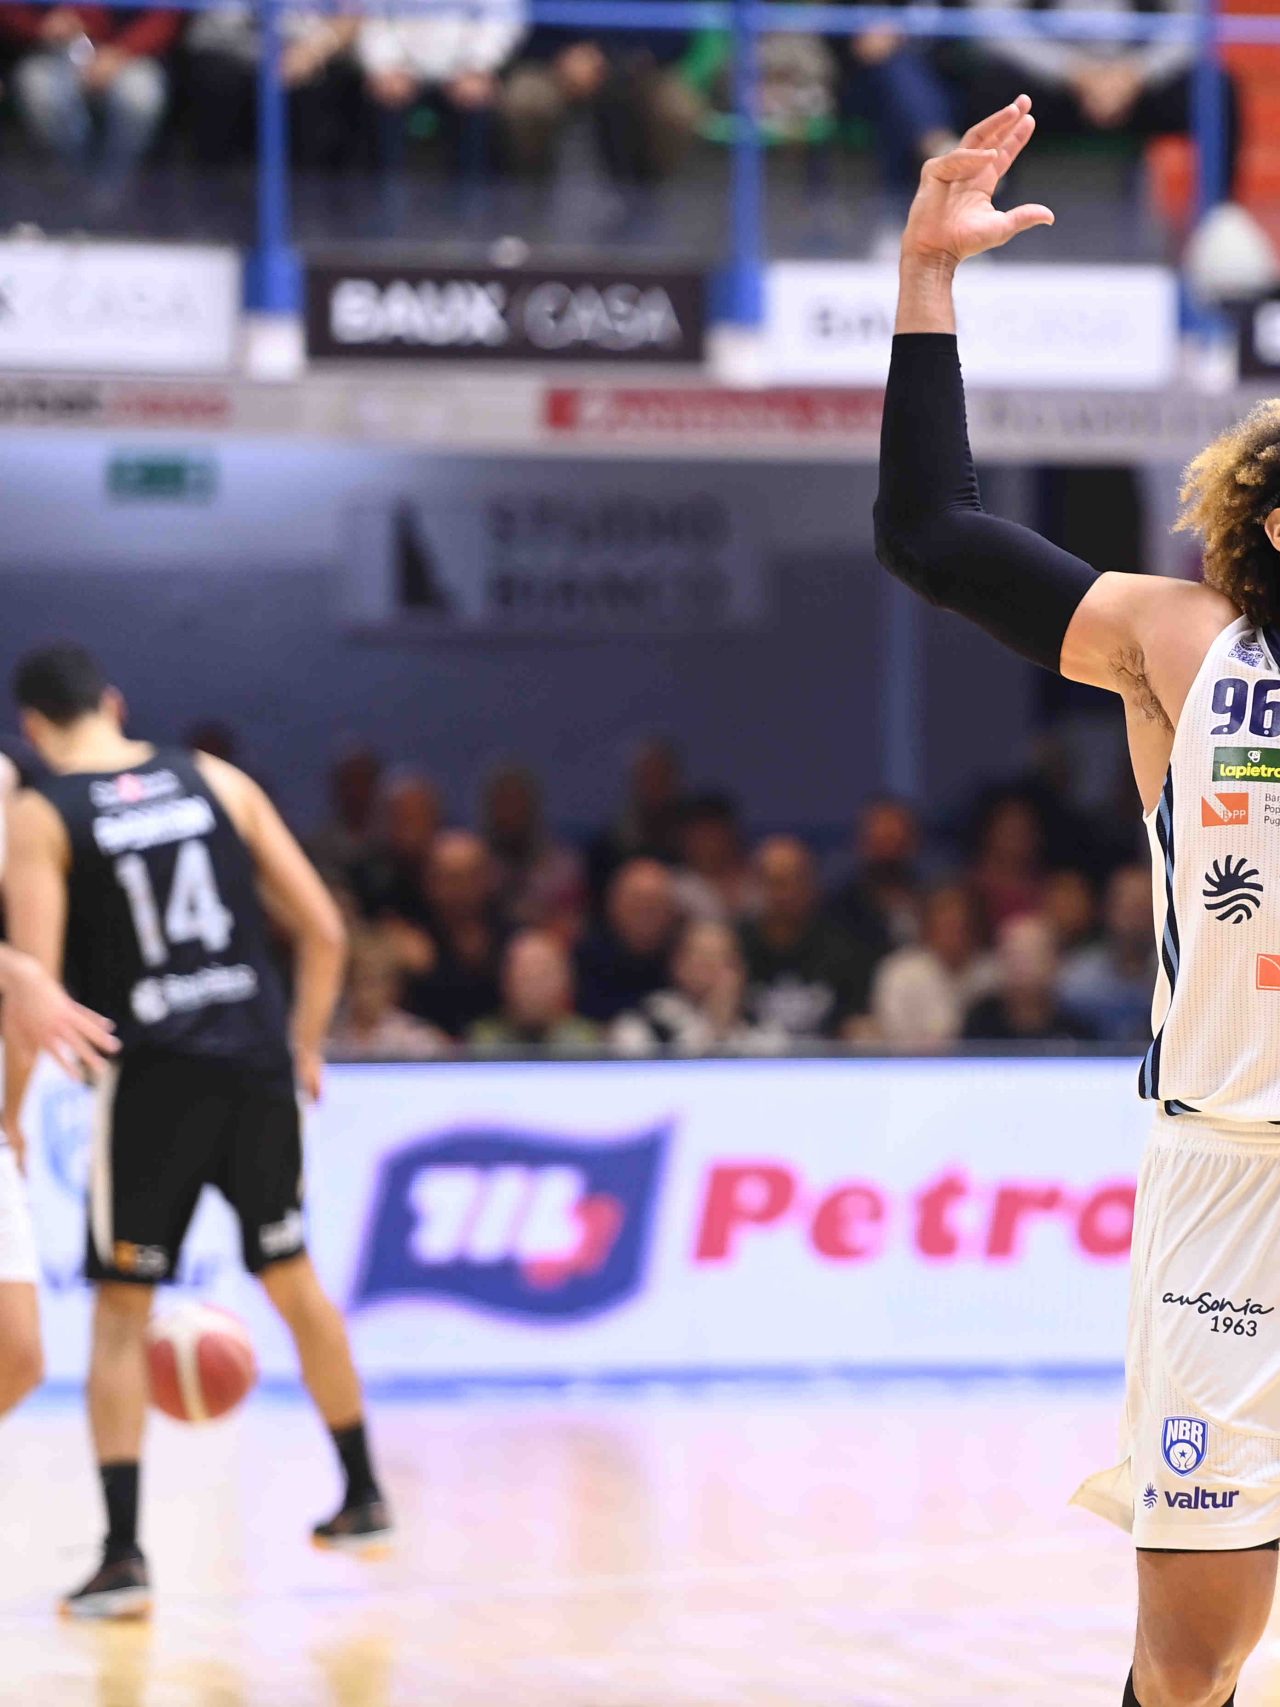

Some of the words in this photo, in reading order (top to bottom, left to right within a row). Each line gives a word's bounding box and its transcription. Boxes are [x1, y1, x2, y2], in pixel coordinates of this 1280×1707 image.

[328, 278, 508, 346] BAUX
[522, 280, 682, 350] CASA
[114, 838, 236, 968] 14
[1210, 1315, 1258, 1337] 1963
[1164, 1486, 1240, 1509] valtur
